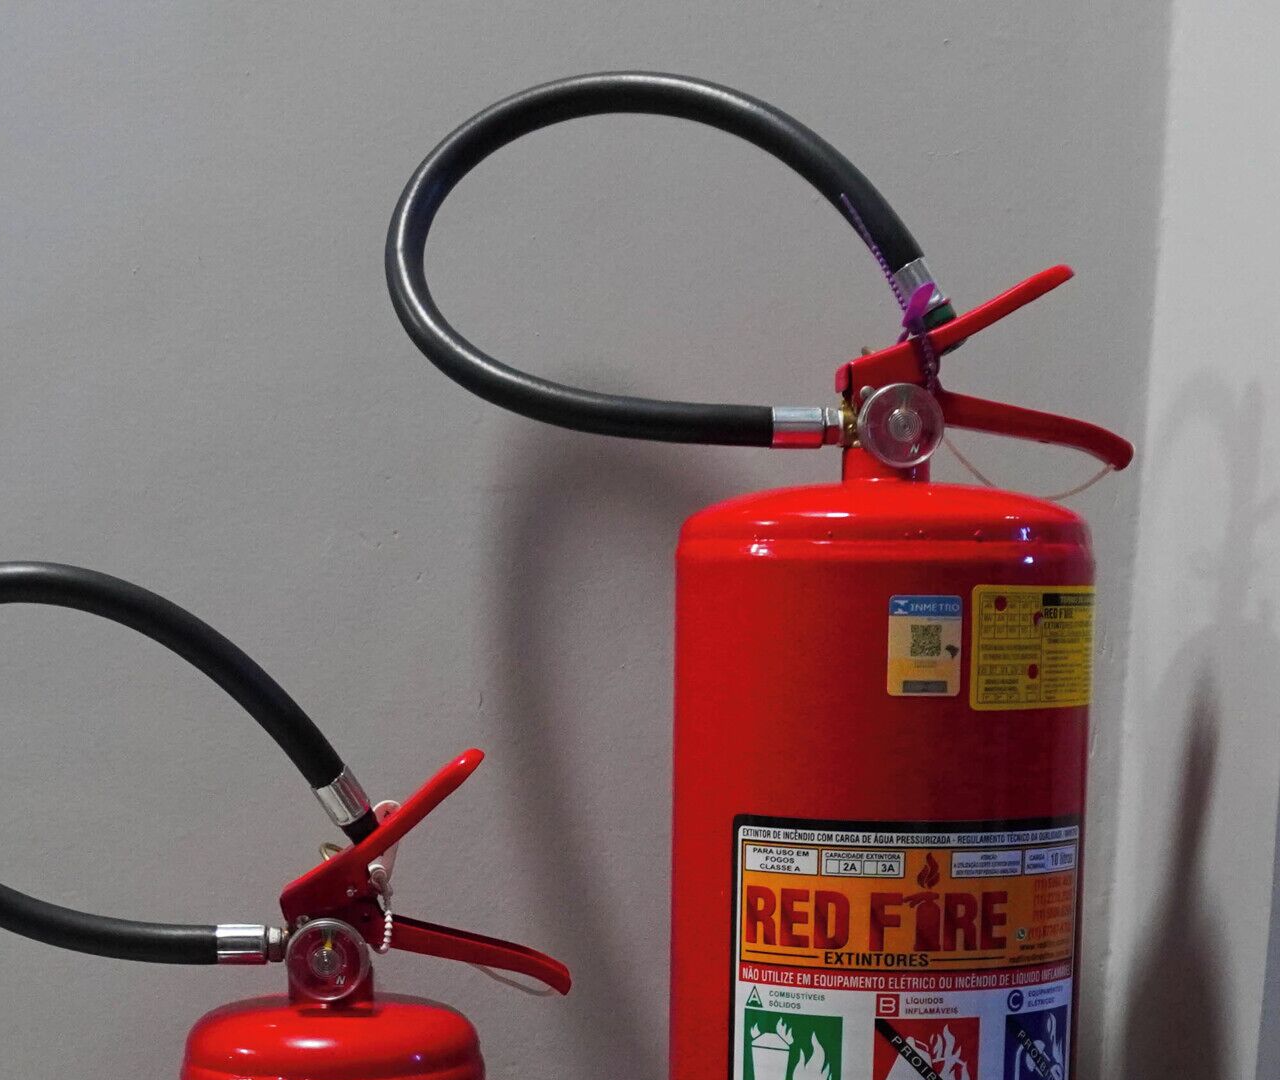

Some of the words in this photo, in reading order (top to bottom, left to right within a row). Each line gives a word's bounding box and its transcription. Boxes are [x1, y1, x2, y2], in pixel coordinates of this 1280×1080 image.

[910, 603, 960, 612] INMETRO
[742, 828, 771, 839] EXTINTOR
[773, 830, 781, 839] DE
[783, 829, 815, 841] INCÊNDIO
[817, 832, 833, 842] COM
[835, 834, 860, 843] CARGA
[862, 835, 871, 844] DE
[873, 832, 893, 844] ÁGUA
[896, 835, 950, 845] PRESSURIZADA
[957, 833, 1005, 844] REGULAMENTO
[752, 847, 774, 855] PARA
[825, 852, 864, 860] CAPACIDADE
[765, 856, 795, 864] FOGOS
[759, 863, 792, 872] CLASSE
[843, 862, 858, 872] 2A
[881, 863, 895, 873] 3A
[745, 885, 850, 950] RED
[869, 889, 1008, 951] FIRE
[824, 951, 929, 967] EXTINTORES
[742, 965, 759, 980] NÃO
[761, 969, 795, 983] UTILIZE
[797, 972, 811, 985] EM
[814, 974, 885, 989] EQUIPAMENTO
[888, 974, 935, 989] ELÉTRICO
[939, 976, 952, 989] OU
[955, 974, 997, 989] INCÊNDIO
[999, 975, 1009, 986] DE
[1011, 969, 1040, 985] LÍQUIDO
[768, 990, 825, 1002] COMBUSTÍVEIS
[905, 996, 944, 1005] LÍQUIDOS
[768, 1000, 801, 1010] SÓLIDOS
[879, 997, 895, 1013] B
[905, 1006, 959, 1015] INFLAMÁVEIS
